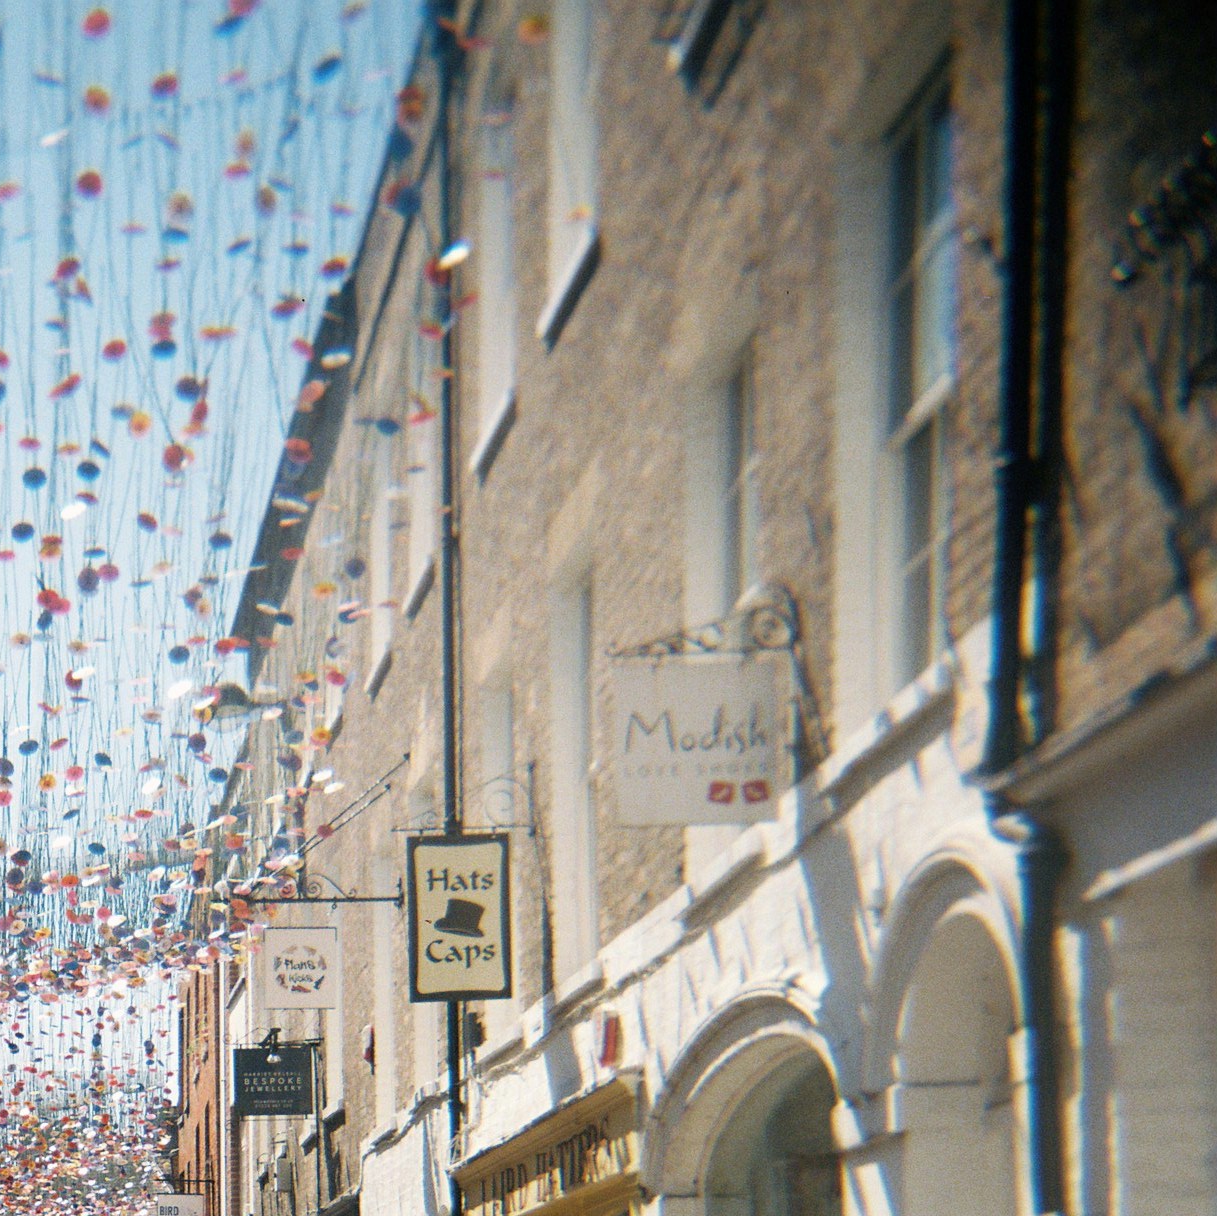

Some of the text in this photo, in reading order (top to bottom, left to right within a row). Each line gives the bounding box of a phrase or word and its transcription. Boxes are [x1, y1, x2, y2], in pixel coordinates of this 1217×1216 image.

[624, 703, 767, 753] Modish
[426, 867, 494, 892] Hats
[425, 939, 496, 969] Caps
[244, 1077, 302, 1085] BESPOKE
[159, 1206, 179, 1216] BIRD
